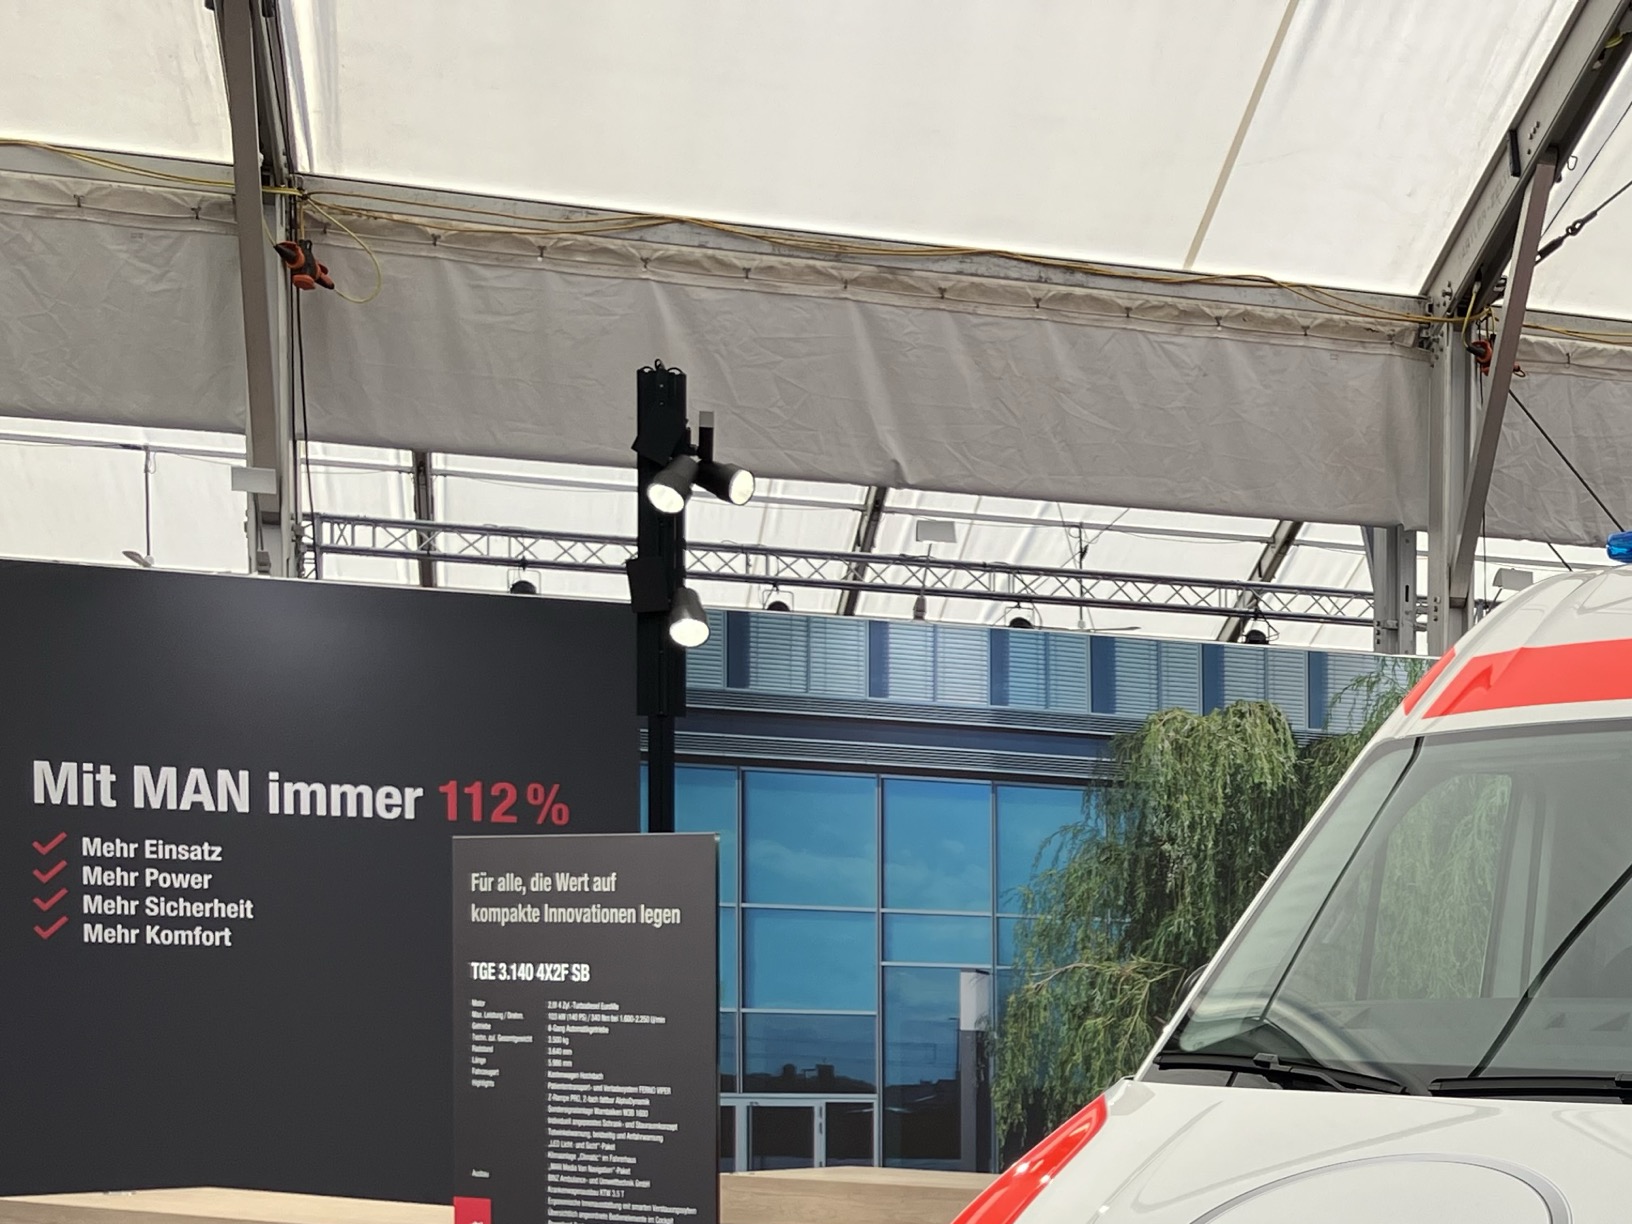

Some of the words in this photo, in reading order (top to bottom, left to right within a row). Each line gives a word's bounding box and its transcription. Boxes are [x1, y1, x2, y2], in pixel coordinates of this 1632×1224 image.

[33, 760, 116, 808] Mit
[134, 765, 249, 813] MAN
[268, 772, 423, 820] immer
[82, 837, 137, 857] Mehr
[144, 839, 221, 861] Einsatz
[82, 866, 138, 886] Mehr
[145, 868, 211, 889] Power
[471, 872, 493, 891] Für
[497, 873, 525, 894] alle,
[530, 873, 551, 891] die
[555, 872, 589, 891] Wert
[592, 872, 616, 892] auf
[82, 895, 138, 914] Mehr
[145, 896, 253, 918] Sicherheit
[471, 903, 540, 925] kompakte
[544, 903, 636, 923] Innovationen
[640, 904, 680, 927] legen
[82, 923, 139, 942] Mehr
[146, 924, 231, 946] Komfort
[471, 962, 495, 980] TGE
[498, 962, 533, 980] 3.140
[536, 963, 568, 981] 4X2F
[571, 963, 589, 981] SB
